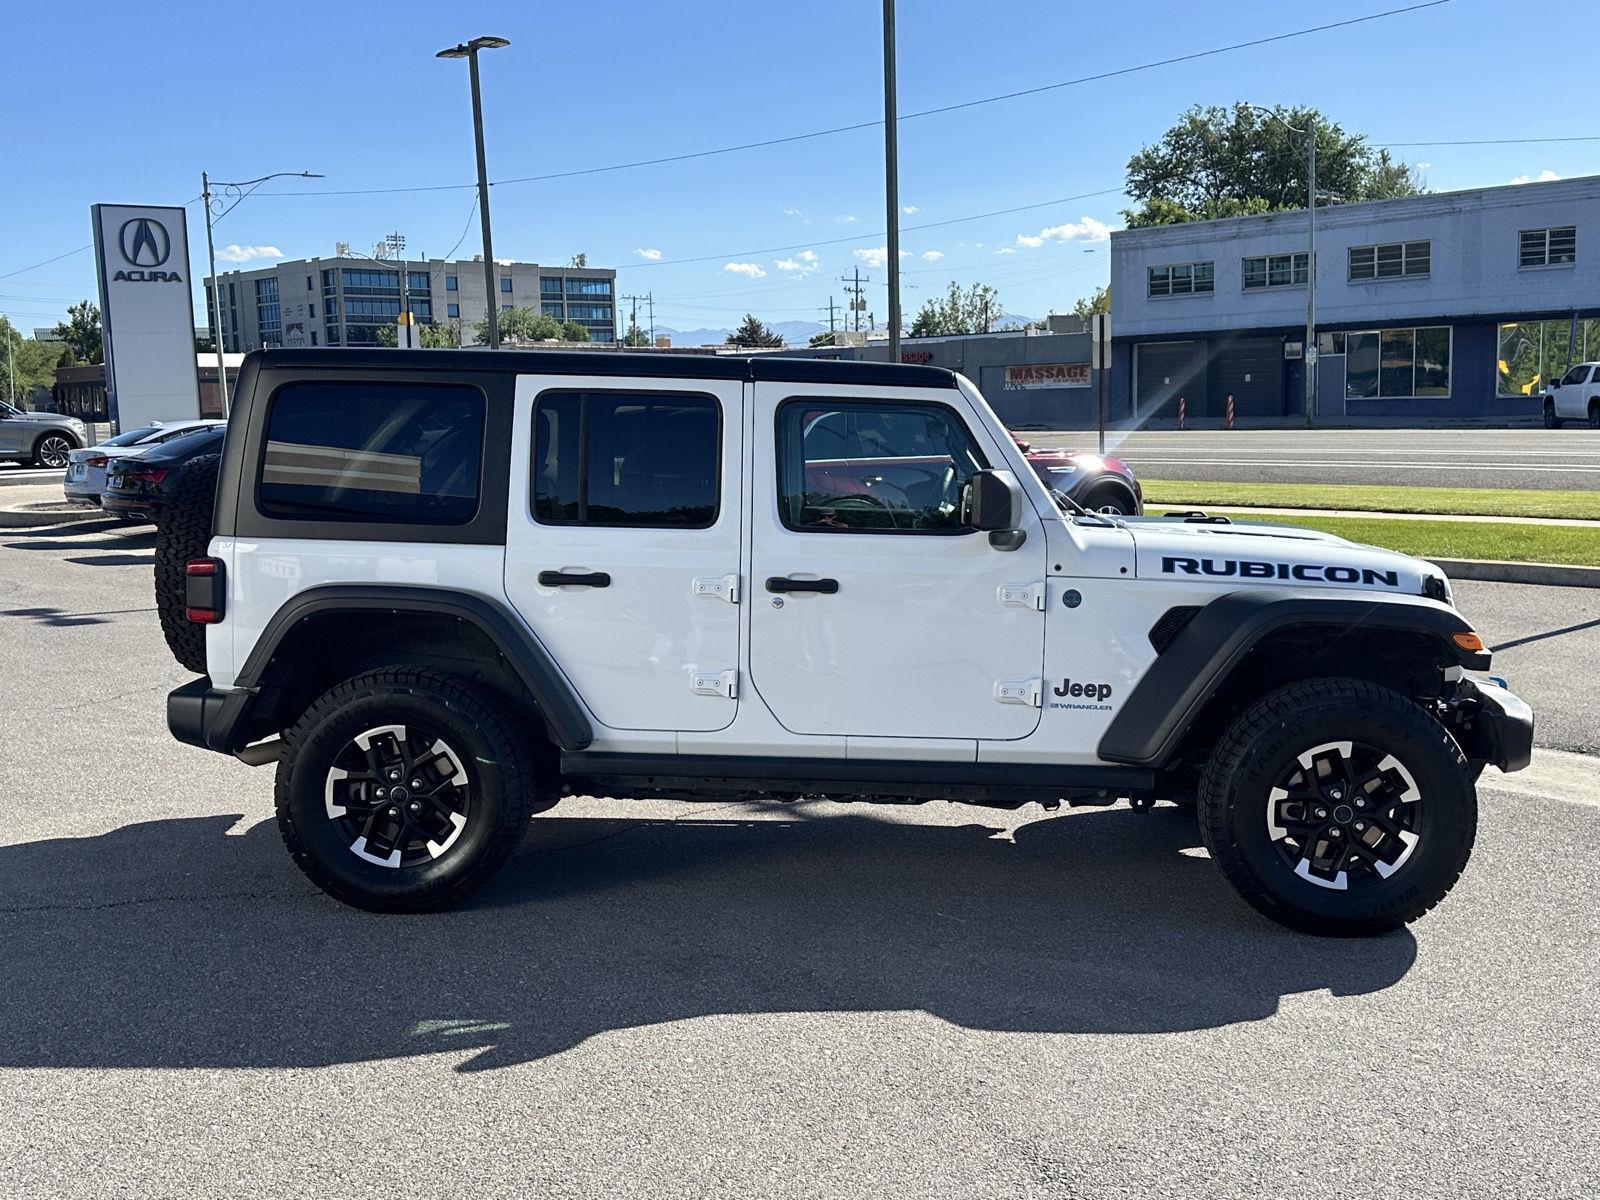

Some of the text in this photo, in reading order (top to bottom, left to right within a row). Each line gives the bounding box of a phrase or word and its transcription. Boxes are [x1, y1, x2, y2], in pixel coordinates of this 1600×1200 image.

[113, 270, 183, 282] ACURA
[1009, 364, 1089, 381] MASSAGE
[1161, 556, 1399, 587] RUBICON
[1053, 678, 1112, 702] Jeep
[1060, 703, 1113, 711] WRANGLER
